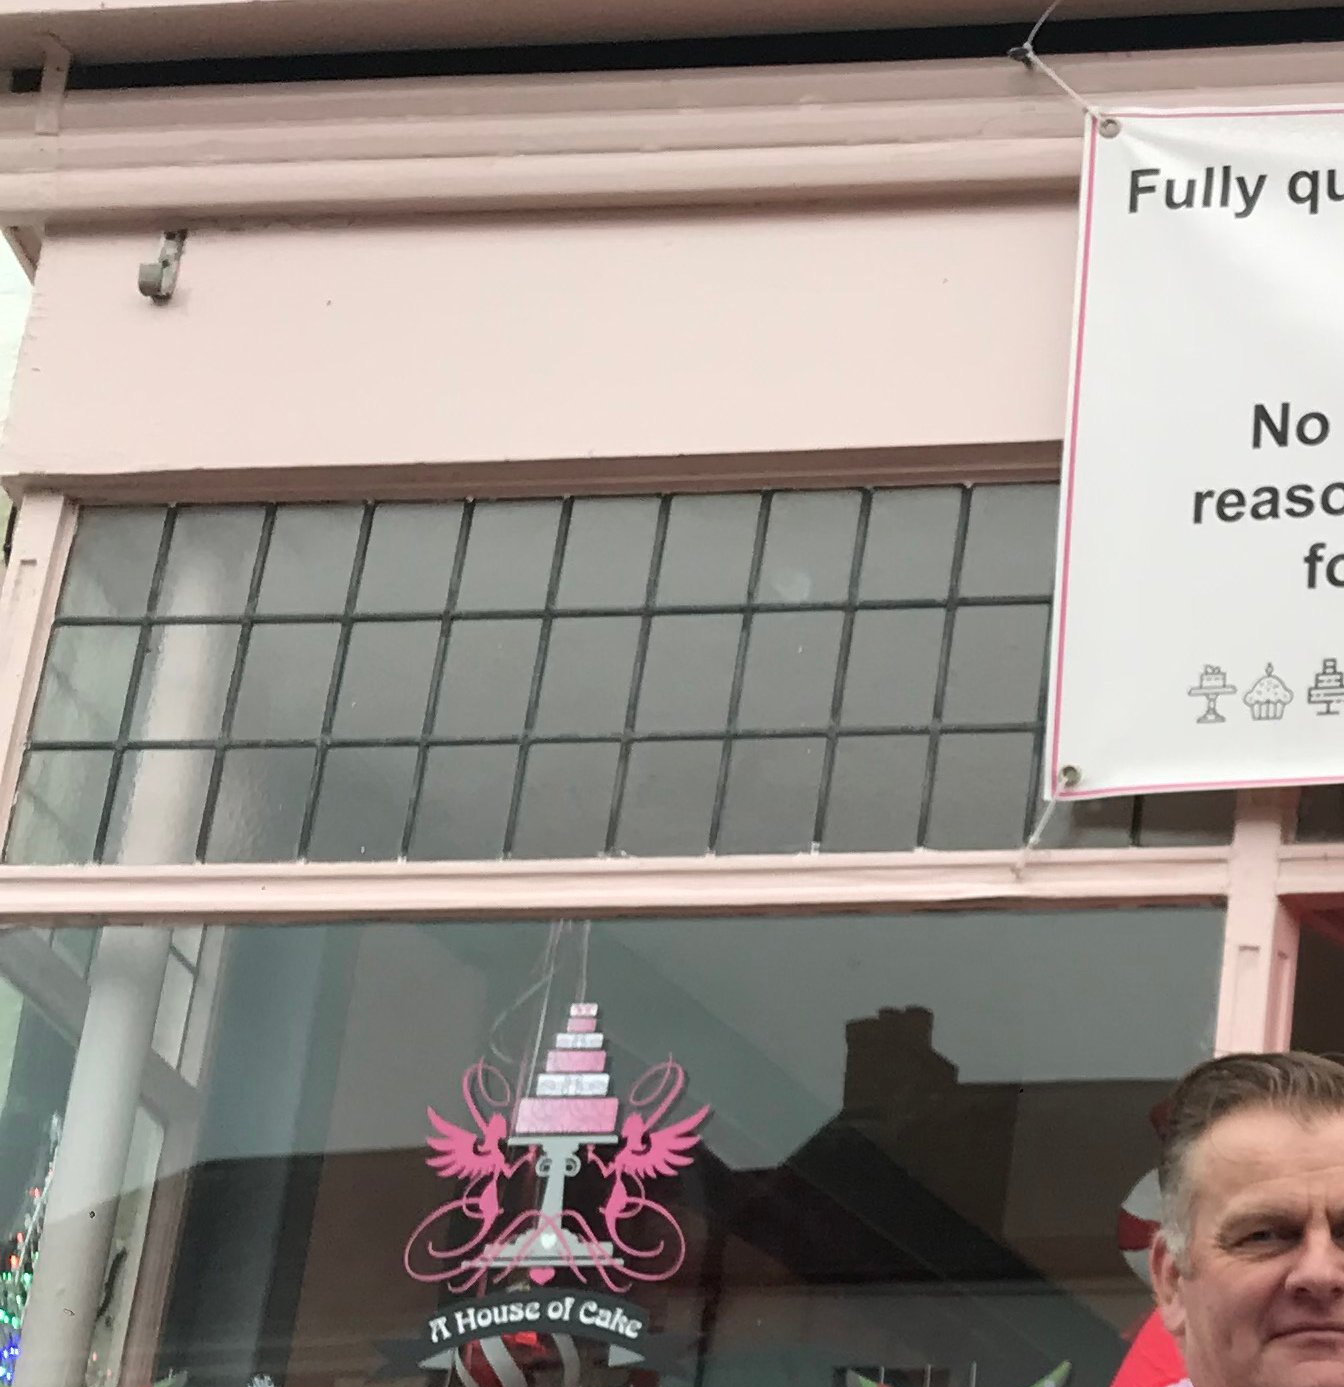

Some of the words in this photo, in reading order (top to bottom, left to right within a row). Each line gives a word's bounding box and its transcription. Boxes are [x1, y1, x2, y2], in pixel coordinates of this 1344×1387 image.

[1129, 165, 1267, 218] Fully
[1252, 402, 1330, 449] No
[428, 1315, 451, 1343] A
[454, 1300, 541, 1335] House
[547, 1296, 576, 1321] of
[579, 1300, 643, 1339] Cake
